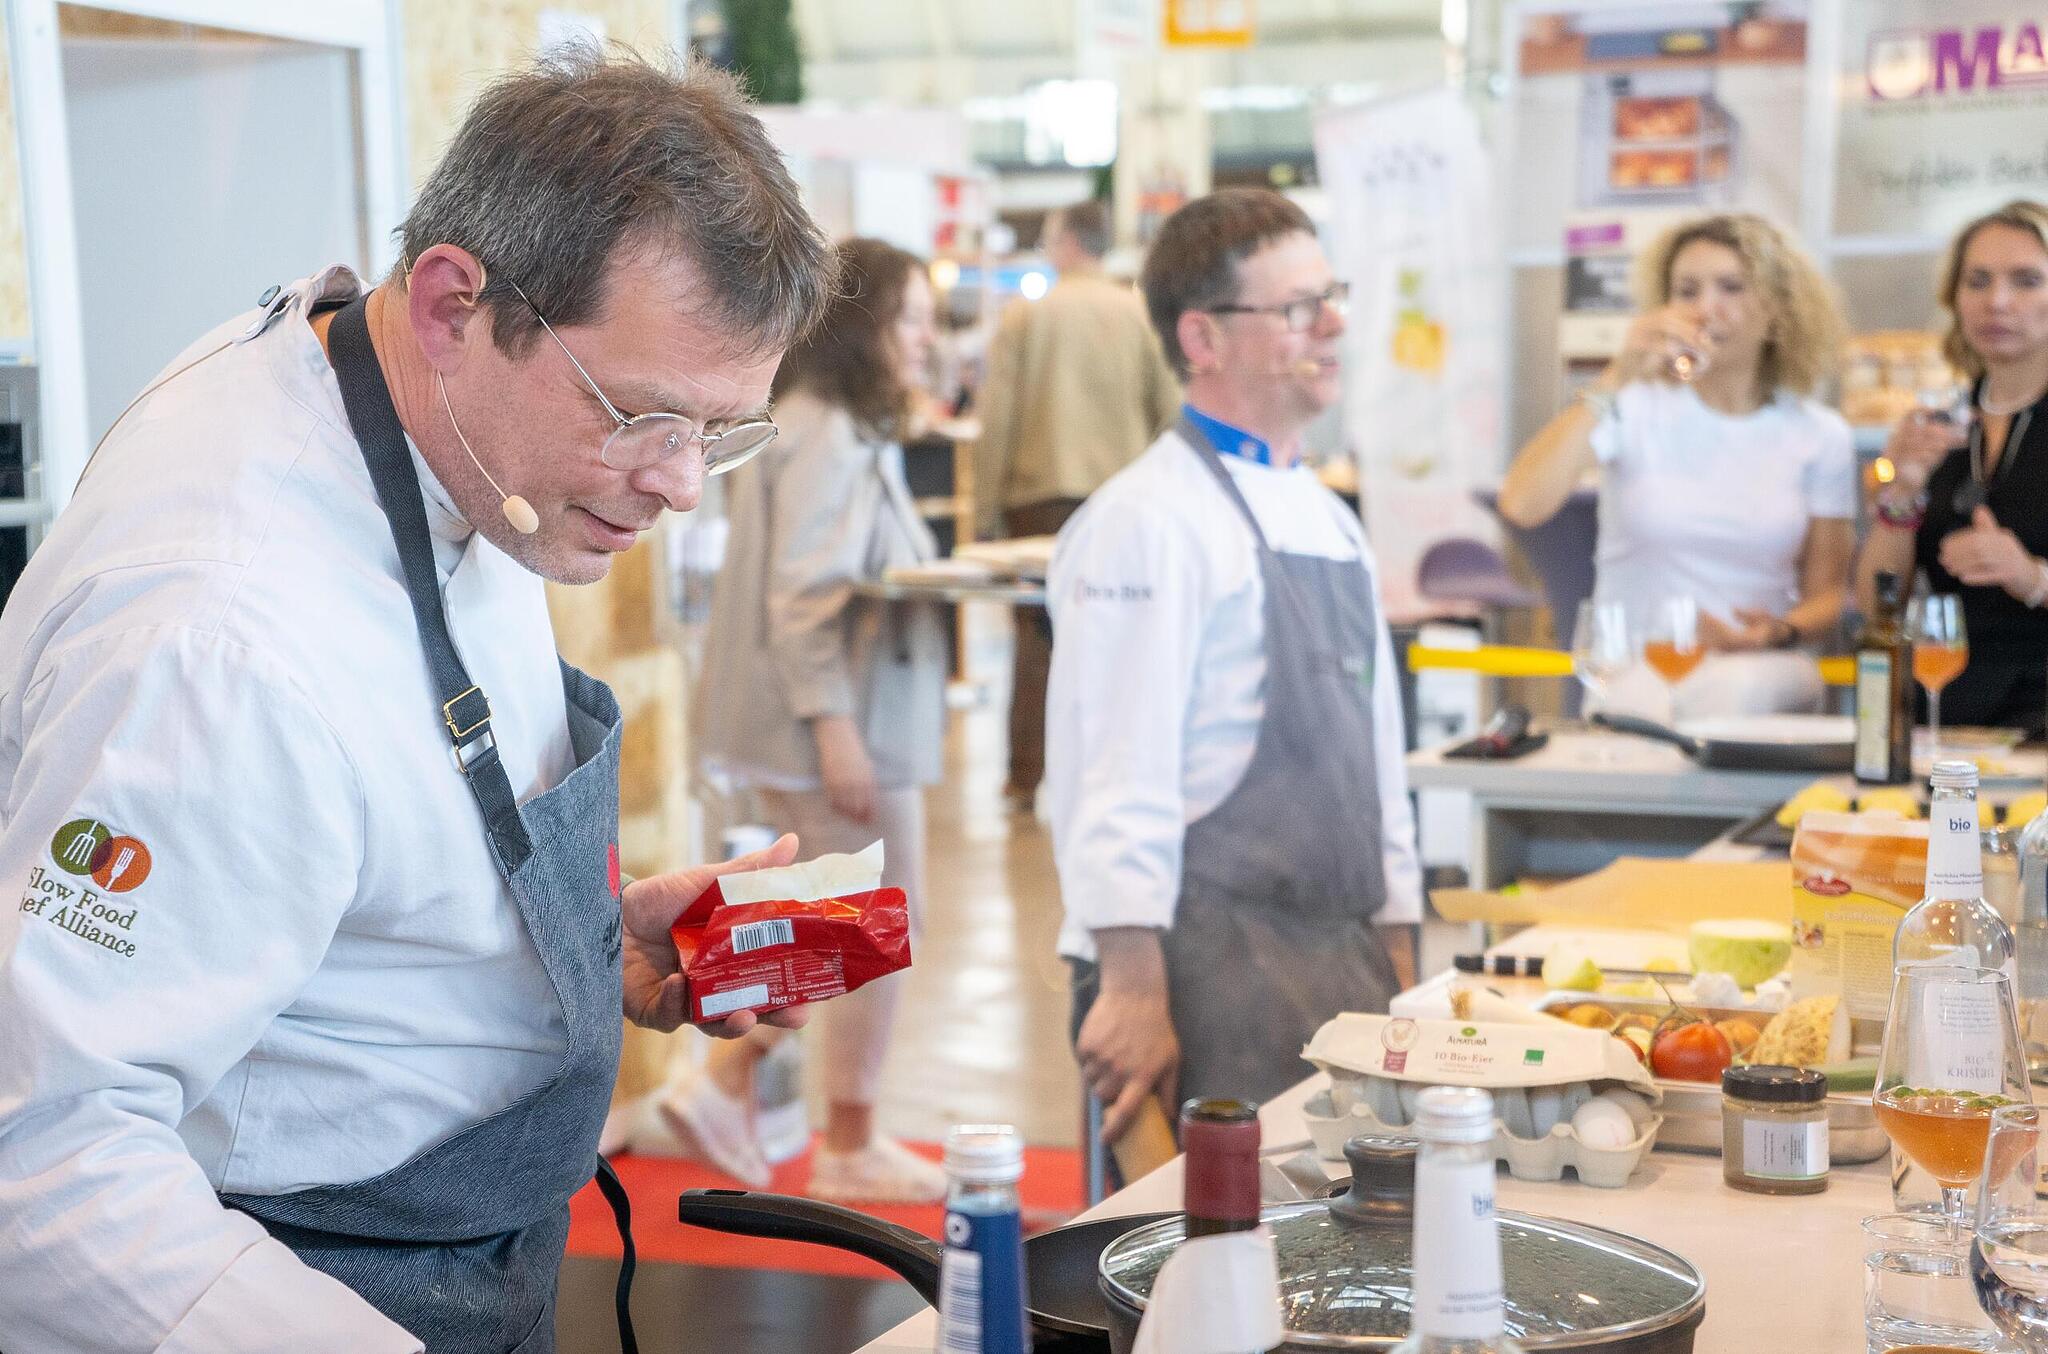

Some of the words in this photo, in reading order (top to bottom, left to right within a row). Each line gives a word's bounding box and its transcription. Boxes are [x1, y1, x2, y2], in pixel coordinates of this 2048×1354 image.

[1949, 817, 1971, 831] bio
[75, 889, 138, 930] Food
[48, 906, 136, 958] Alliance
